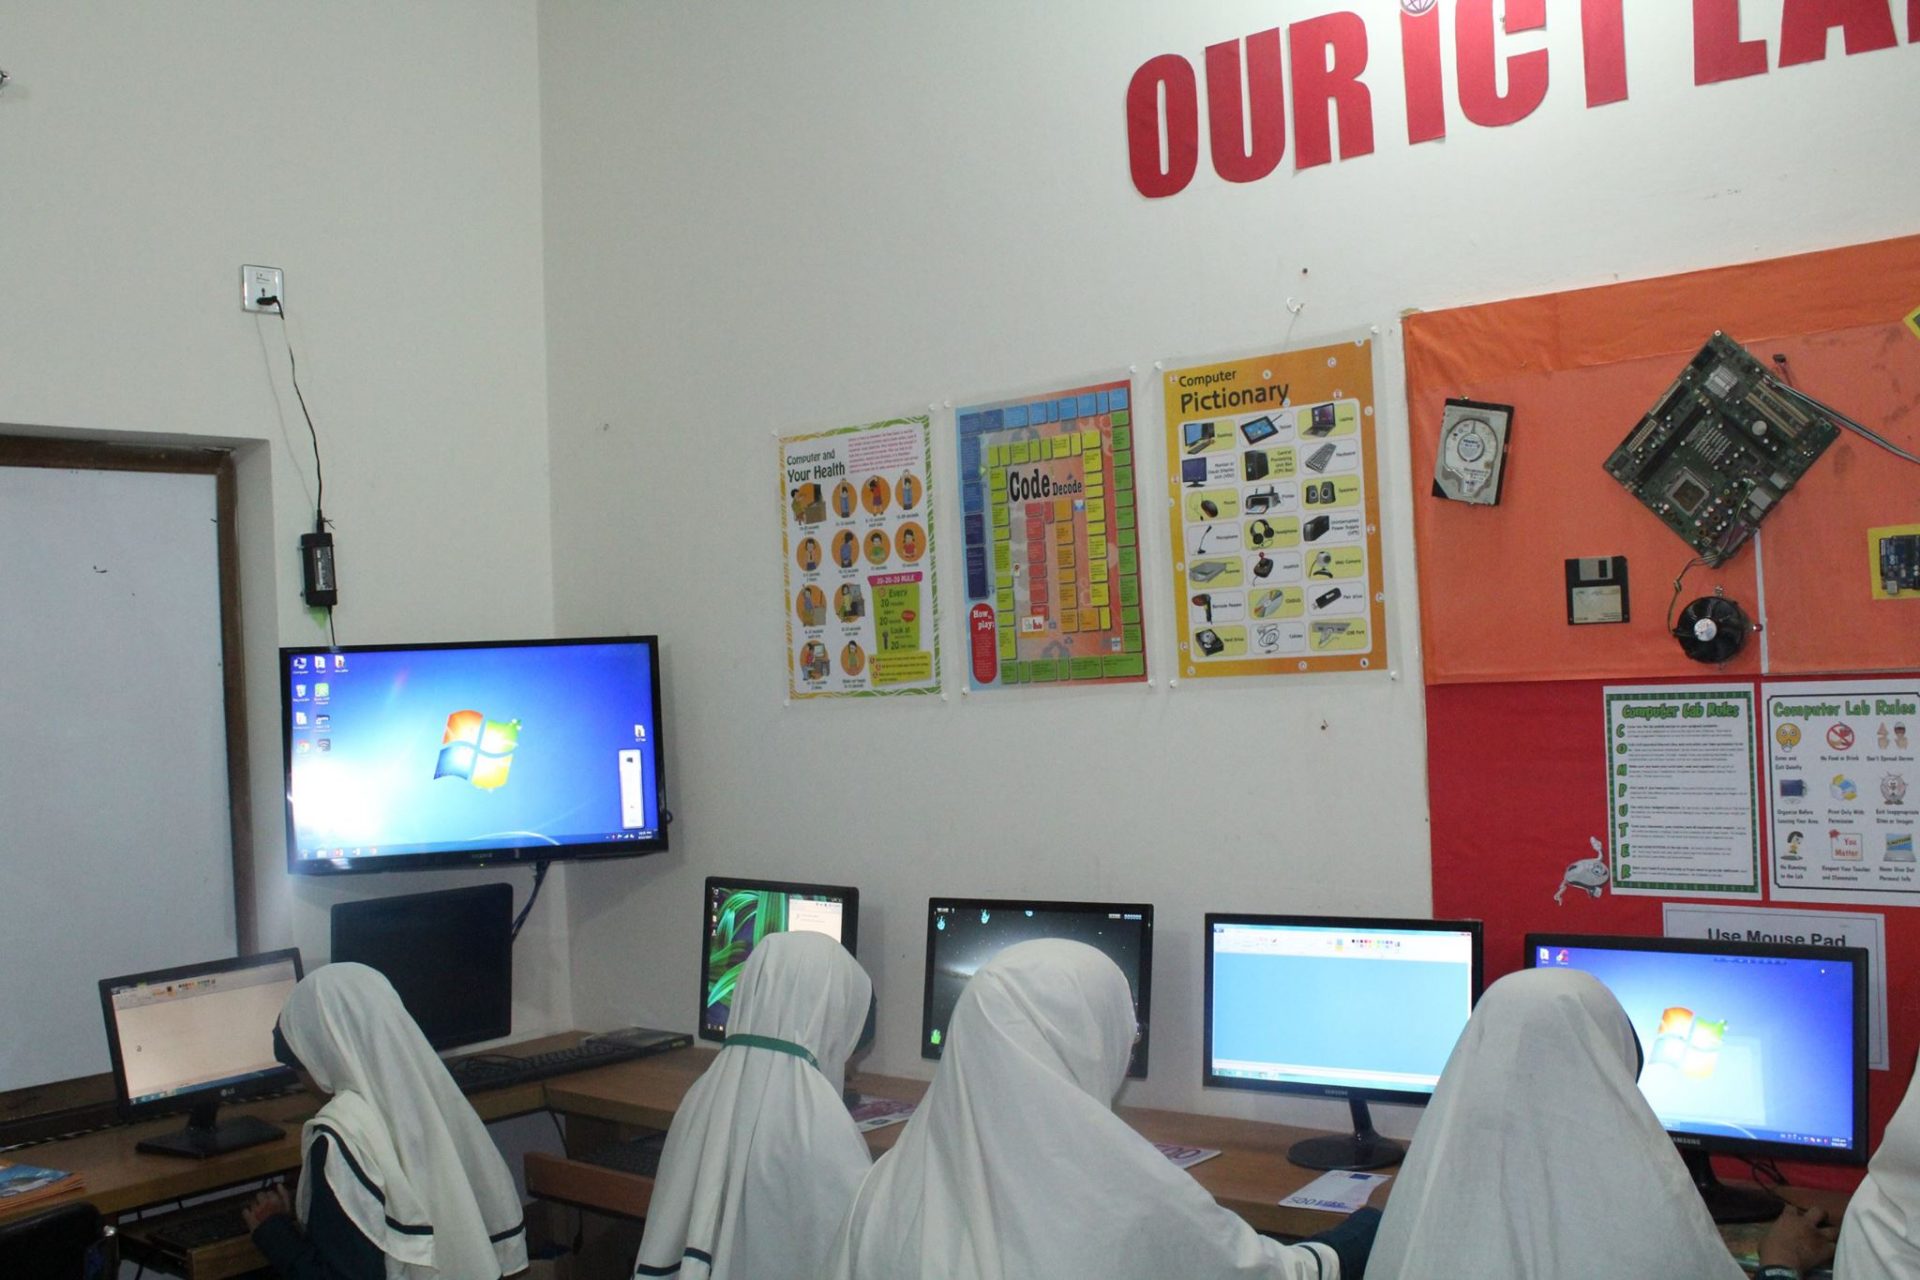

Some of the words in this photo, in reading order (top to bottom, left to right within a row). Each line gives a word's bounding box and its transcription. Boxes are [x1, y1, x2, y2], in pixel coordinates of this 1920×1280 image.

[1126, 10, 1374, 198] OUR
[1179, 370, 1236, 387] Computer
[1180, 384, 1290, 414] Pictionary
[787, 452, 821, 466] Computer
[823, 449, 836, 460] and
[788, 468, 810, 482] Your
[814, 462, 845, 480] Health
[1010, 468, 1050, 502] Code
[1052, 480, 1082, 496] Decode
[901, 574, 914, 582] RULE
[1622, 703, 1680, 720] Computer
[1682, 702, 1704, 718] Lab
[1707, 702, 1740, 718] Rules
[1774, 702, 1840, 720] Computer
[1845, 700, 1870, 716] Lab
[1875, 699, 1916, 715] Rules
[1708, 928, 1741, 941] Use
[1747, 930, 1804, 945] Mouse
[1811, 934, 1846, 947] Pad
